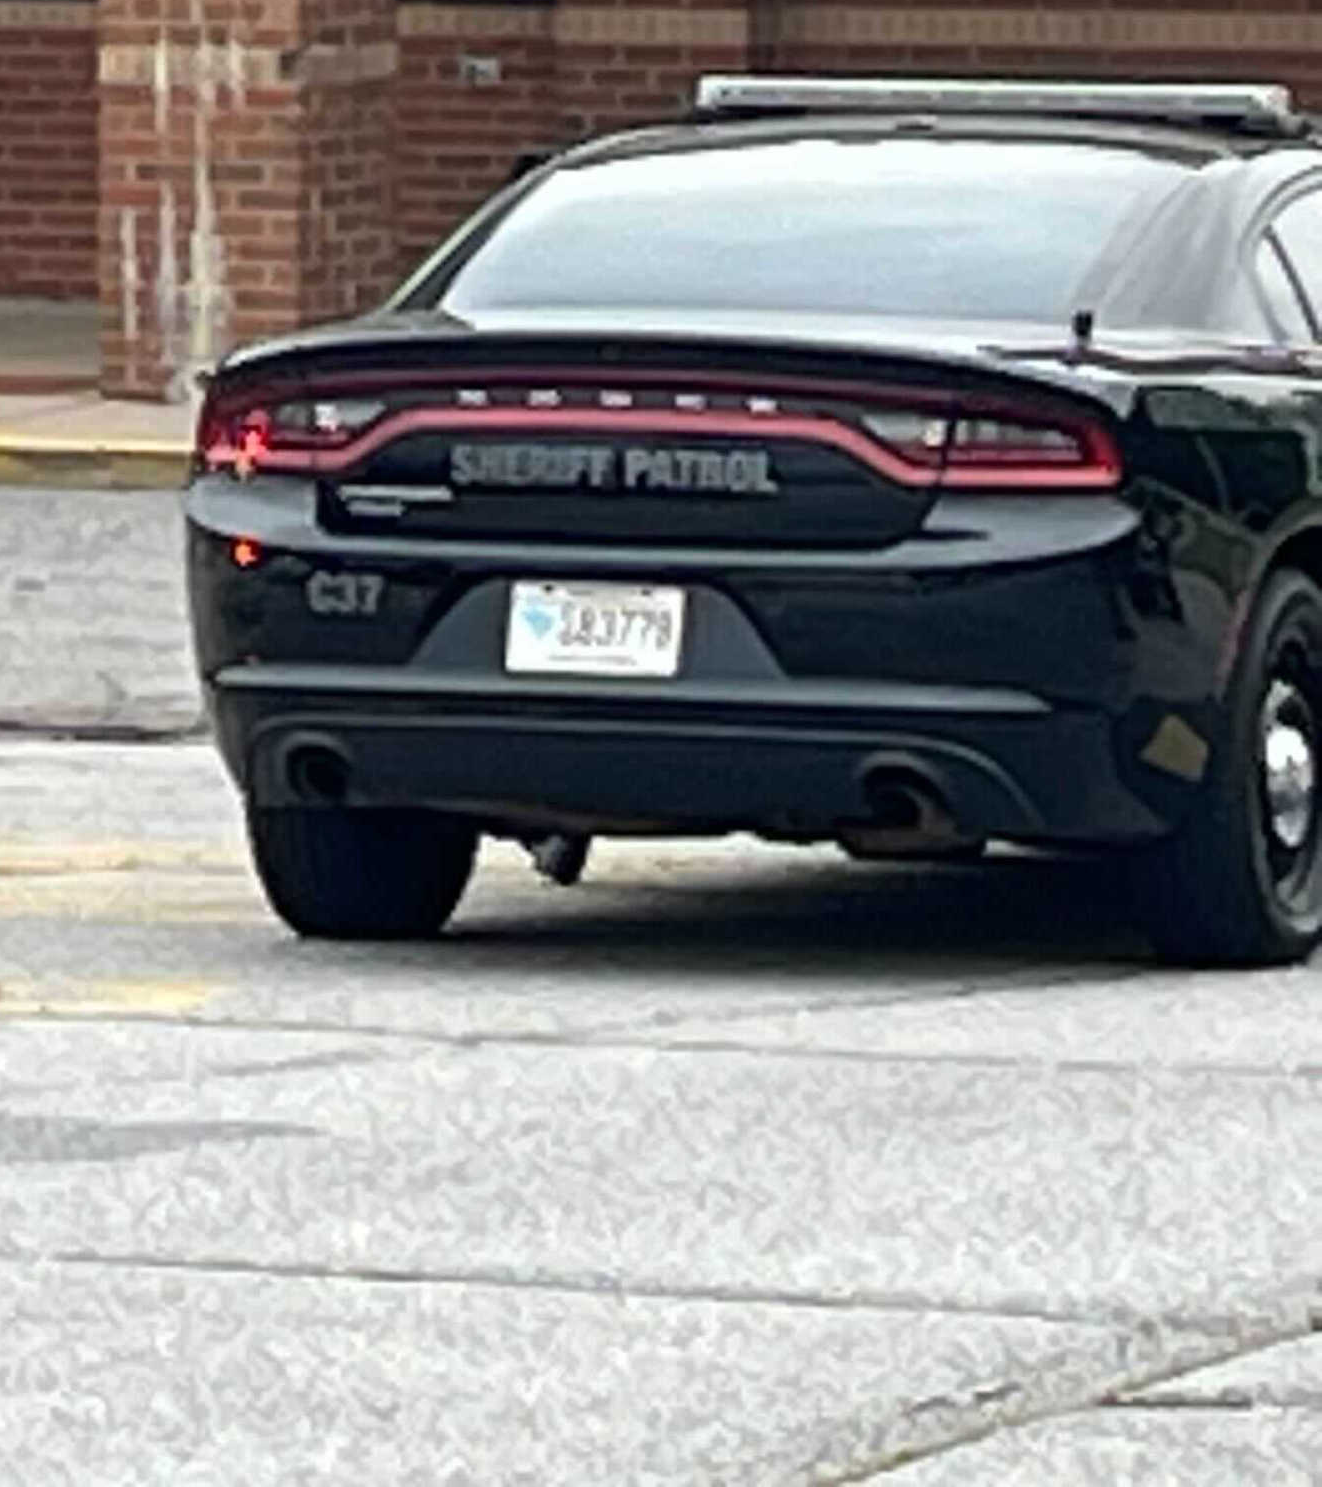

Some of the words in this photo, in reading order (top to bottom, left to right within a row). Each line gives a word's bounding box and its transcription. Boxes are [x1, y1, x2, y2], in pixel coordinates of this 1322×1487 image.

[451, 444, 614, 486] SHERIFF
[624, 447, 777, 493] PATROL
[306, 571, 384, 613] C37
